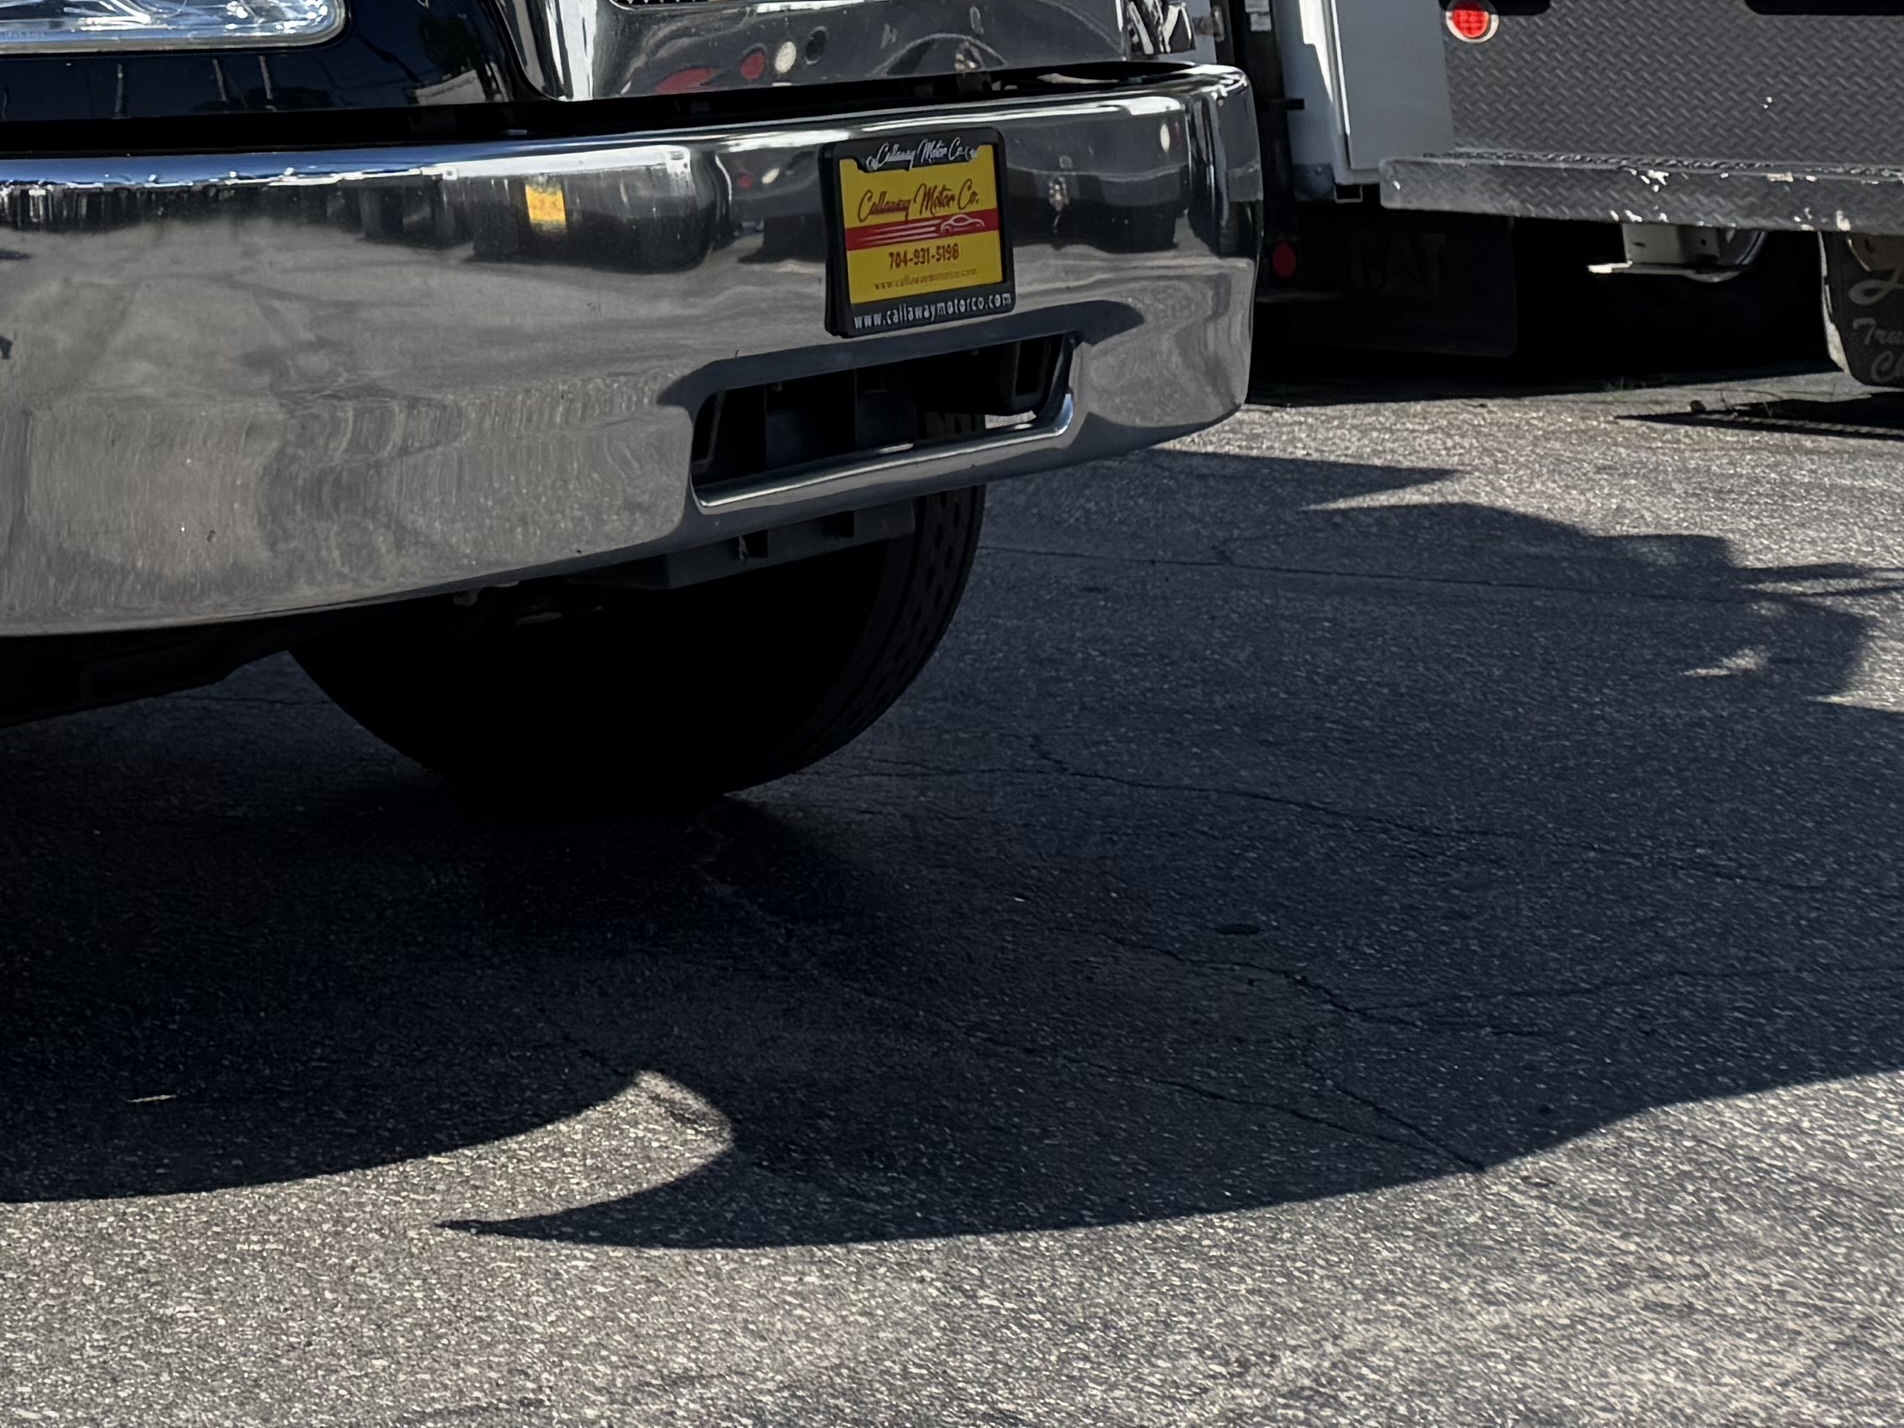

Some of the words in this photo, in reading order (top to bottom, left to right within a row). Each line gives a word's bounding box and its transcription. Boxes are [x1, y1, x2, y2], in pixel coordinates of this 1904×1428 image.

[858, 189, 911, 223] Callaway
[914, 182, 956, 217] Motor
[957, 178, 980, 211] Co.
[888, 243, 960, 270] 704-931-5198
[1349, 232, 1447, 298] CAT
[854, 292, 1012, 329] www.callawaymotorco.com
